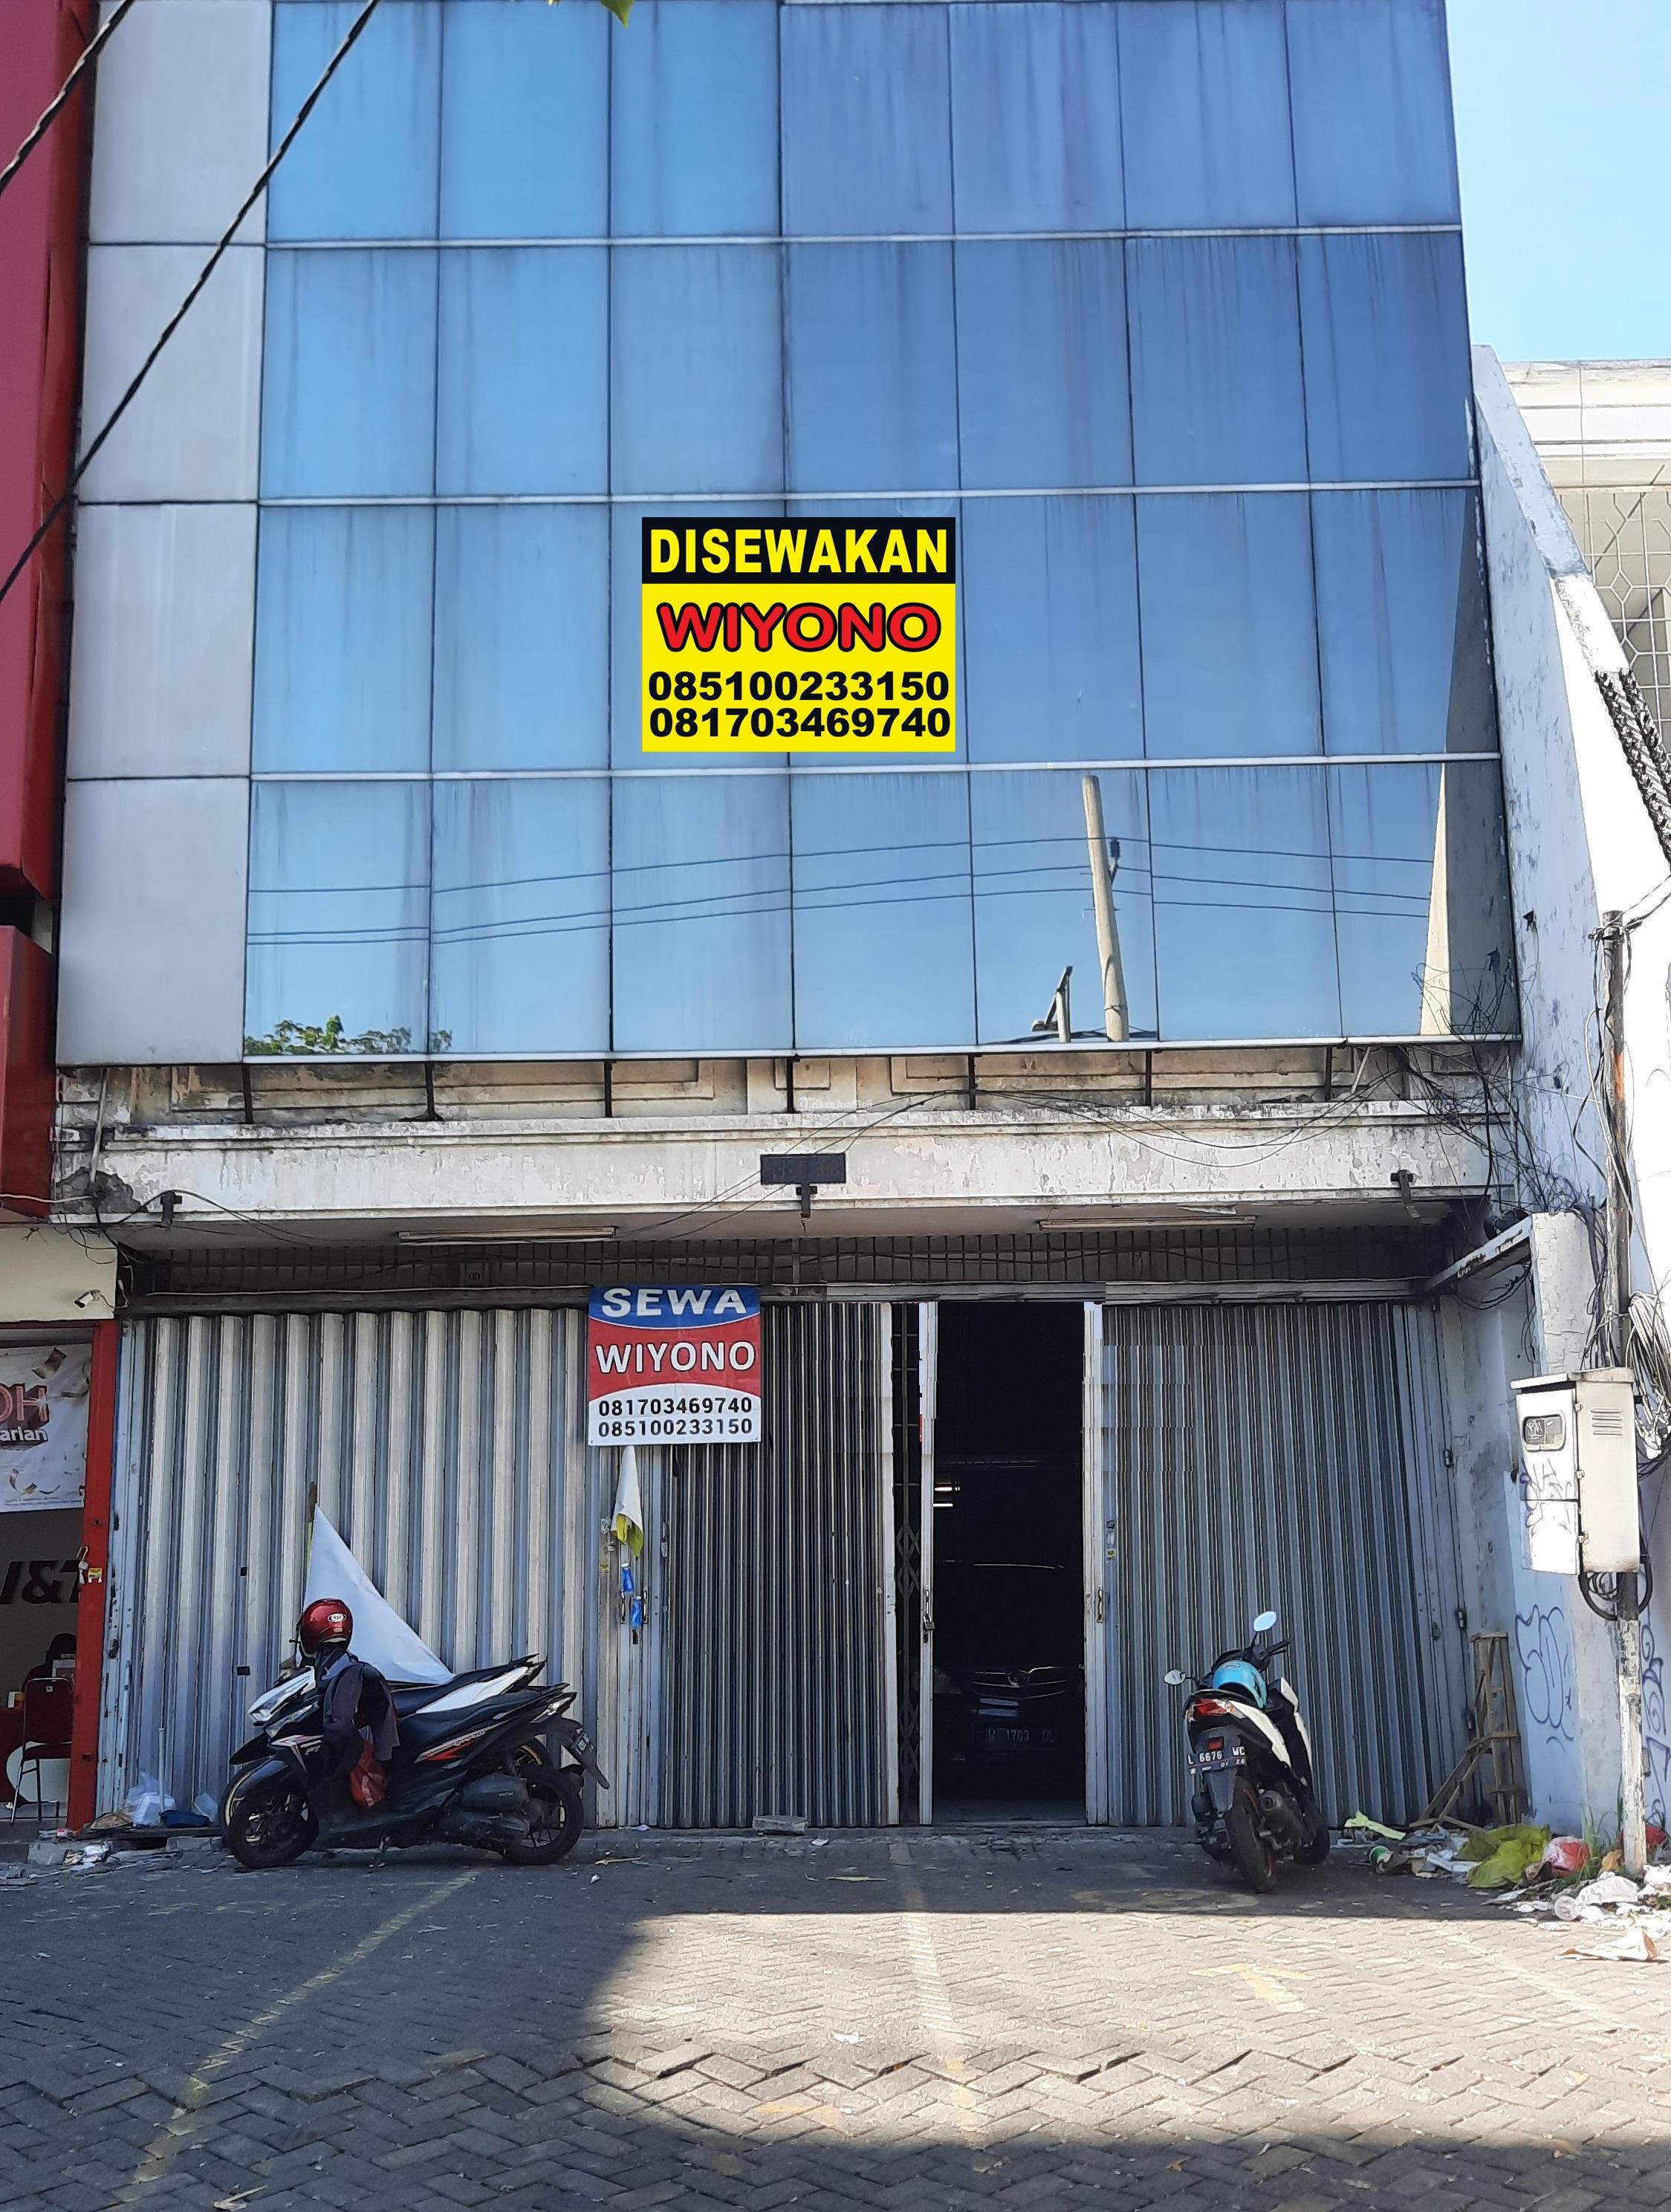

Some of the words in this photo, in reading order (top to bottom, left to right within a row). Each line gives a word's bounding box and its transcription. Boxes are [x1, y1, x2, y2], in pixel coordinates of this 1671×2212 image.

[601, 1288, 747, 1317] SEWA
[595, 1340, 756, 1374] WIYONO
[599, 1397, 752, 1417] 081703469740
[598, 1418, 753, 1438] 085100233150
[1187, 1754, 1194, 1765] L
